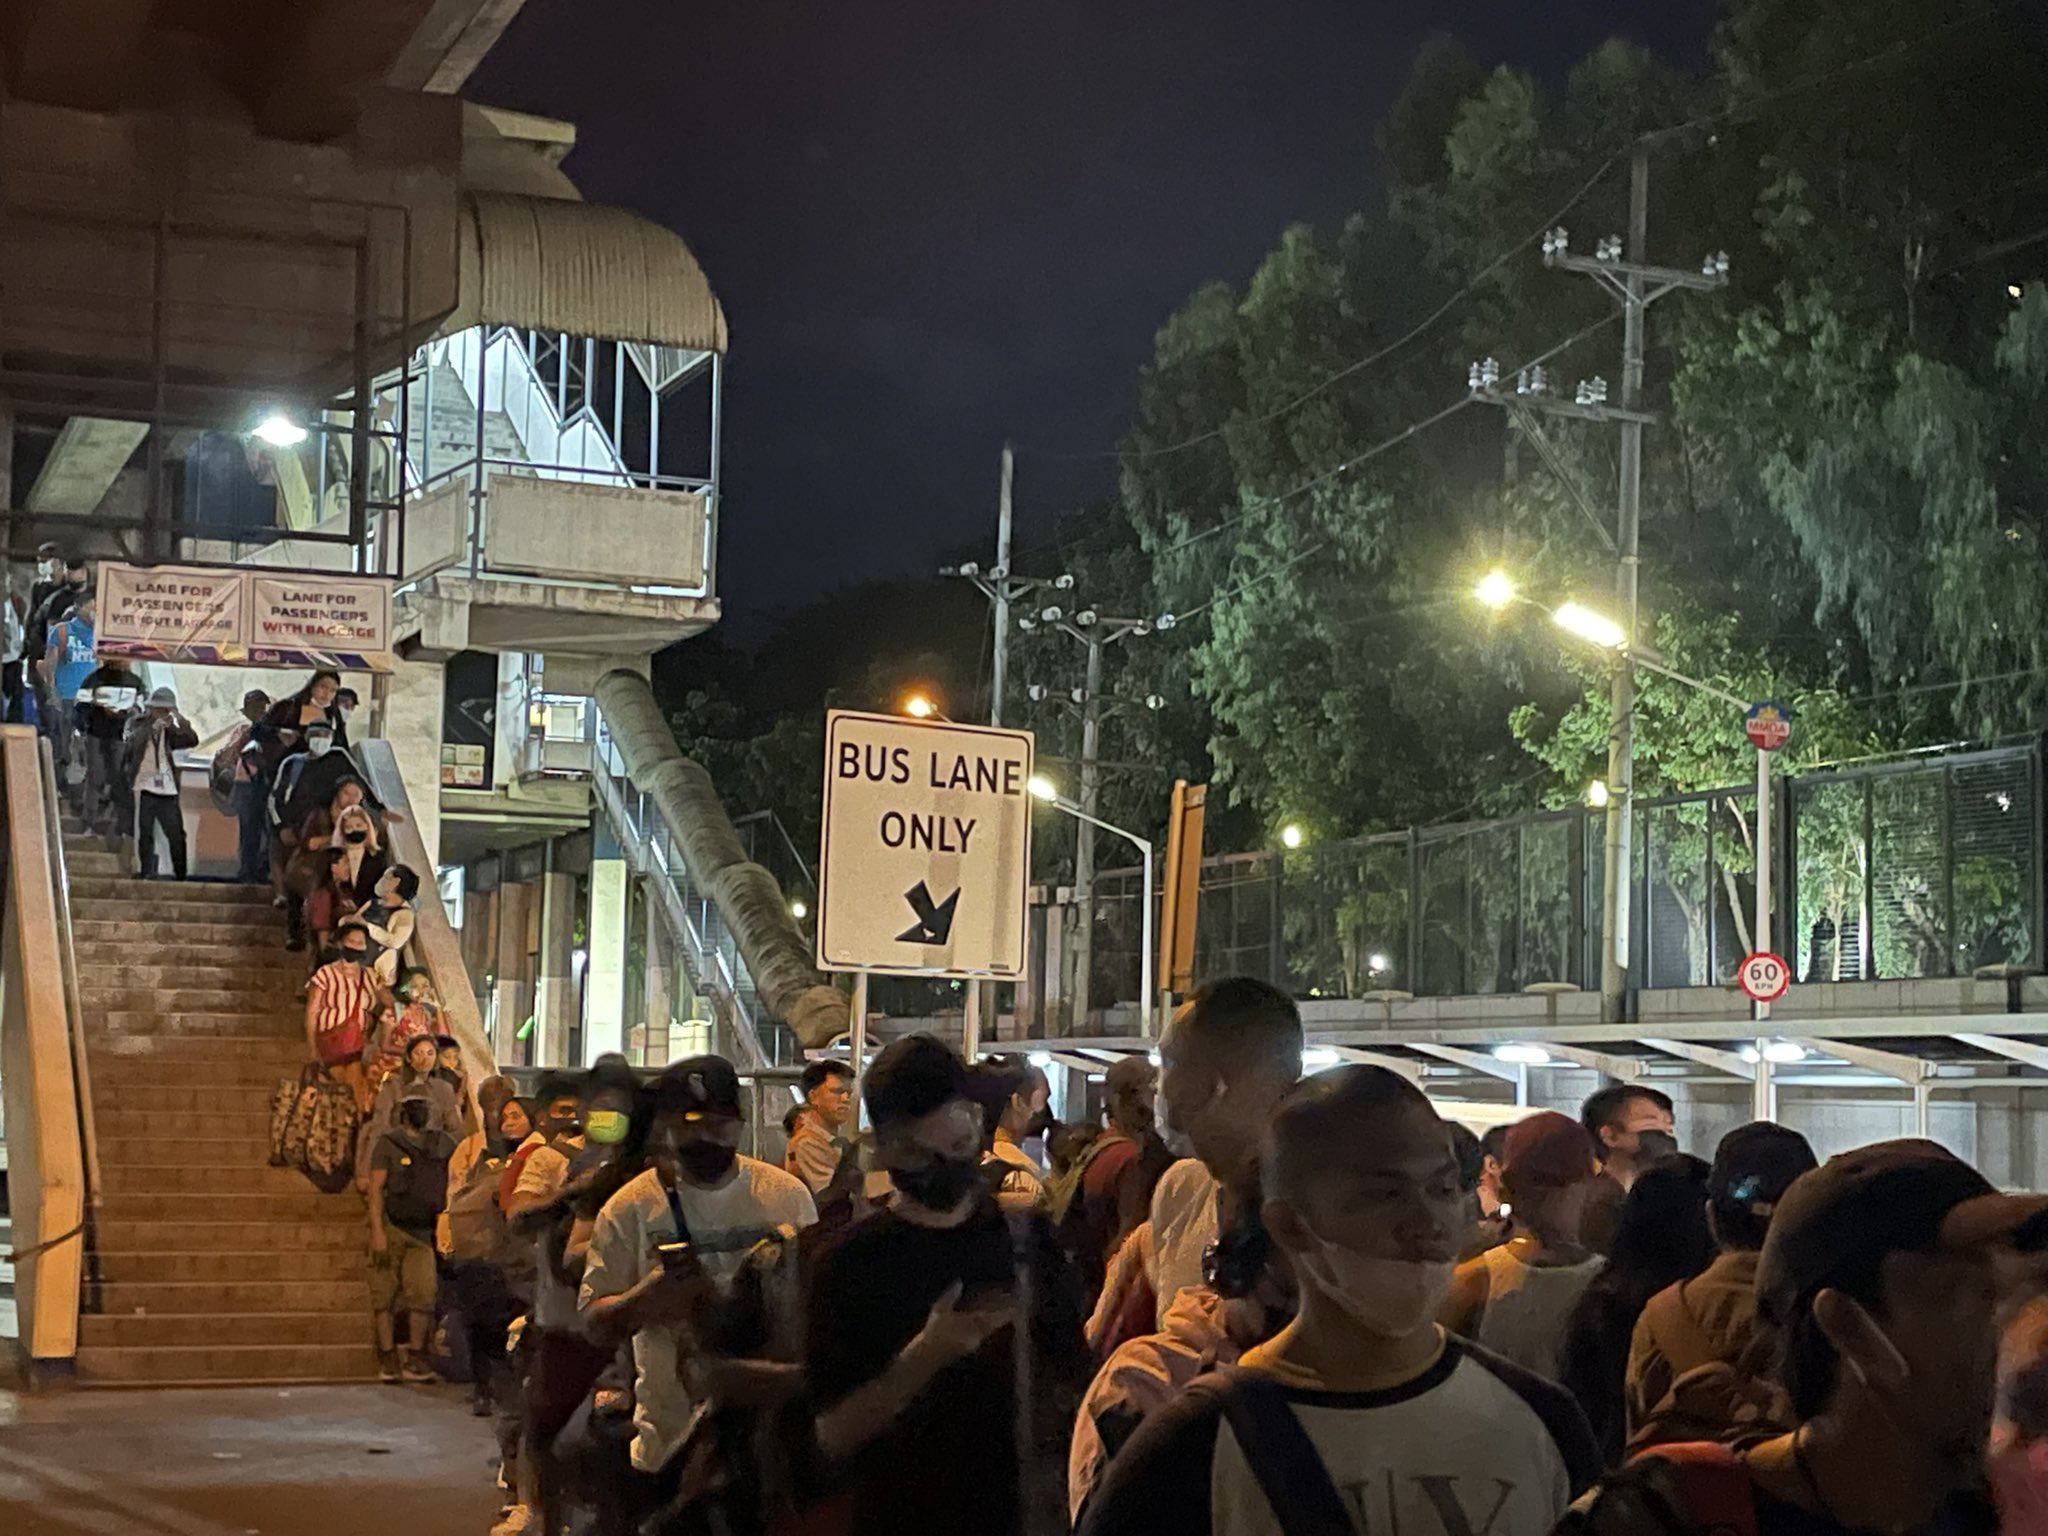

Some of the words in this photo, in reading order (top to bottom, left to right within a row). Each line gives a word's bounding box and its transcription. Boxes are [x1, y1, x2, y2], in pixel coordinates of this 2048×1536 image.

[136, 583, 177, 595] LANE
[181, 586, 212, 597] FOR
[122, 597, 225, 613] PASSENGERS
[283, 592, 323, 604] LANE
[327, 594, 356, 605] FOR
[271, 606, 368, 622] PASSENGERS
[263, 621, 302, 634] WITH
[838, 742, 910, 784] BUS
[930, 752, 1021, 796] LANE
[880, 811, 976, 853] ONLY
[1750, 963, 1778, 981] 60
